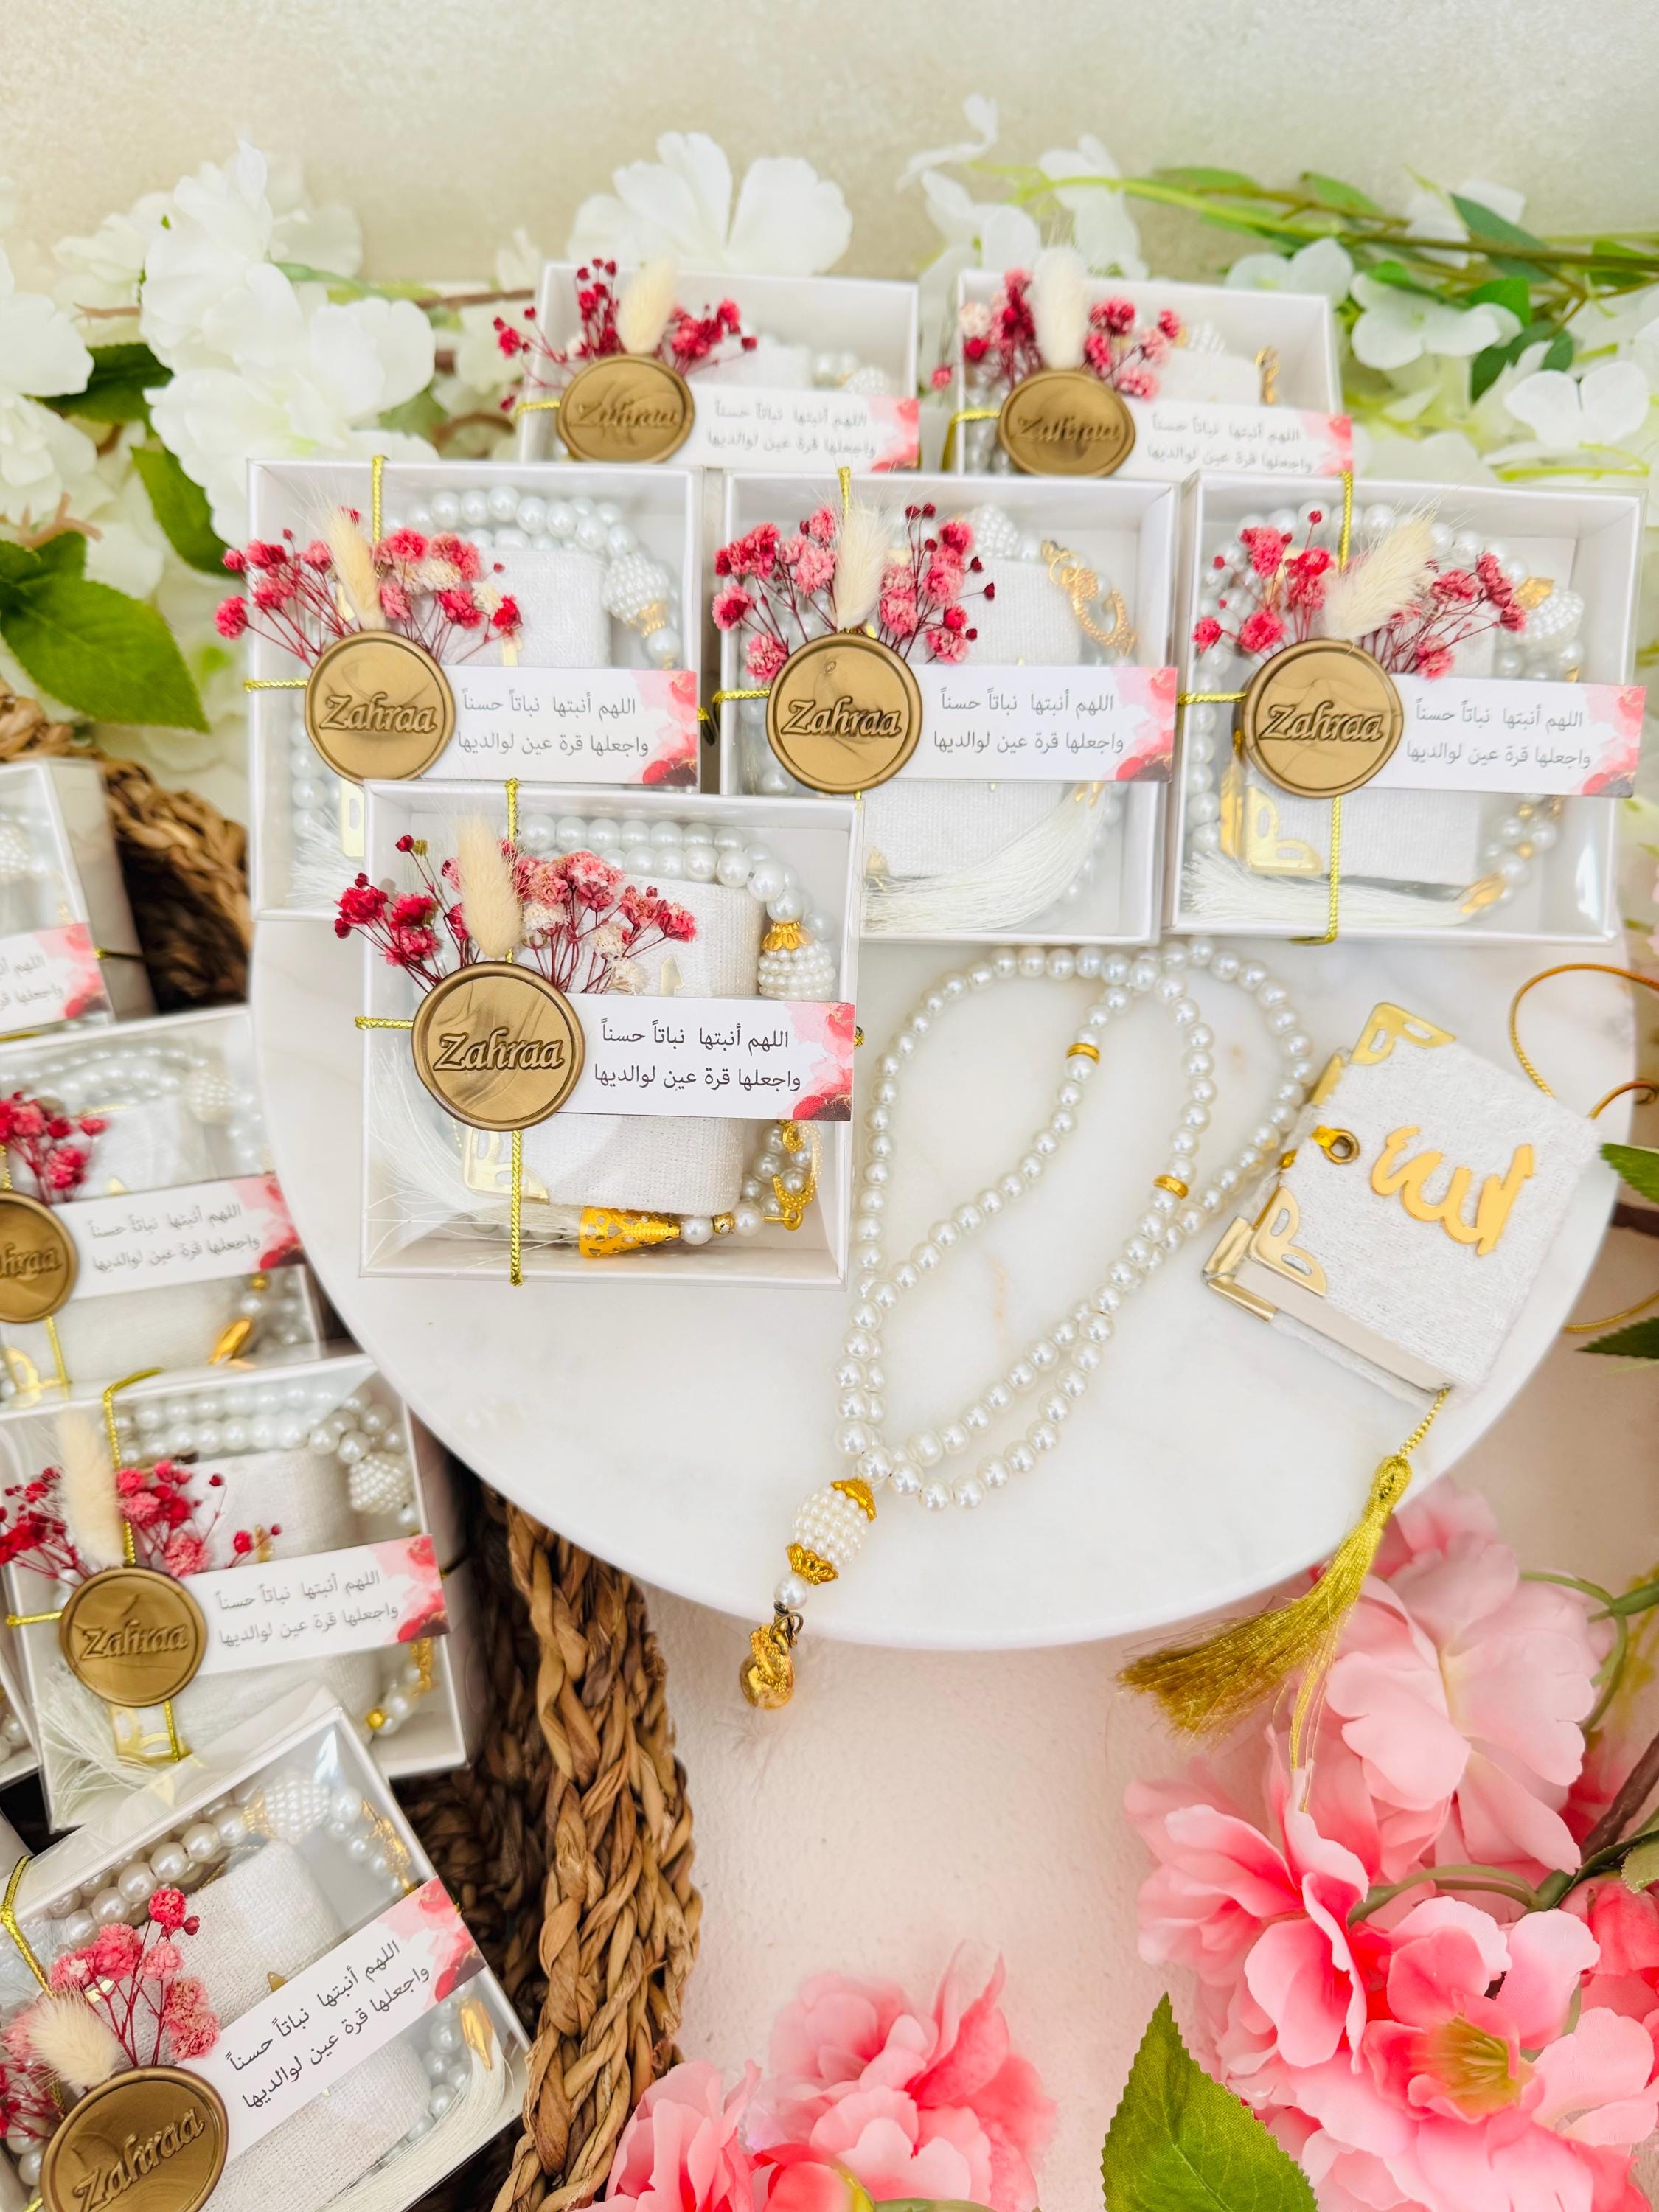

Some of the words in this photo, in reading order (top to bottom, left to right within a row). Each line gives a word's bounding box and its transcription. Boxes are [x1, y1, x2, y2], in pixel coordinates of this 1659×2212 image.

[319, 692, 437, 733] Zahraa
[553, 692, 591, 717] أنبتها
[599, 698, 635, 723] اللهم
[1031, 689, 1069, 715] أنبتها
[1076, 695, 1113, 720] اللهم
[781, 696, 902, 737] Zahraa
[1259, 701, 1383, 742] Zahraa
[1503, 704, 1541, 729] أنبتها
[1545, 712, 1582, 734] اللهم
[459, 731, 514, 754] لوالديها
[522, 737, 552, 755] عين
[560, 734, 583, 756] قرة
[591, 735, 648, 757] واجعلها
[934, 731, 990, 753] لوالديها
[997, 737, 1027, 754] عين
[1035, 732, 1058, 754] قرة
[1066, 733, 1123, 754] واجعلها
[1407, 742, 1462, 764] لوالديها
[1469, 749, 1498, 765] عين
[1506, 745, 1528, 767] قرة
[1535, 748, 1590, 769] واجعلها
[602, 1018, 645, 1042] حسناً
[652, 1020, 684, 1051] نباتاً
[700, 1023, 741, 1051] أنبتها
[434, 1026, 564, 1071] Zahraa
[748, 1030, 788, 1056] اللهم
[595, 1064, 655, 1088] لوالديها
[664, 1071, 696, 1091] عين
[705, 1068, 730, 1090] قرة
[739, 1068, 800, 1091] واجعلها
[0, 1242, 63, 1279] hraa
[302, 1573, 338, 1600] أنبتها
[344, 1571, 380, 1596] اللهم
[314, 1614, 336, 1632] قرة
[343, 1603, 399, 1627] واجعلها
[80, 1618, 189, 1659] Zahraa
[220, 1623, 272, 1647] لوالديها
[280, 1622, 307, 1638] عين
[364, 1940, 400, 1983] اللهم
[317, 1966, 358, 2007] أنبتها
[370, 1967, 430, 2013] واجعلها
[271, 2008, 309, 2037] نباتاً
[341, 2012, 368, 2034] قرة
[226, 2039, 273, 2070] حسناً
[310, 2034, 339, 2065] عين
[243, 2056, 304, 2111] لوالديها
[72, 2107, 206, 2212] Zahraa
